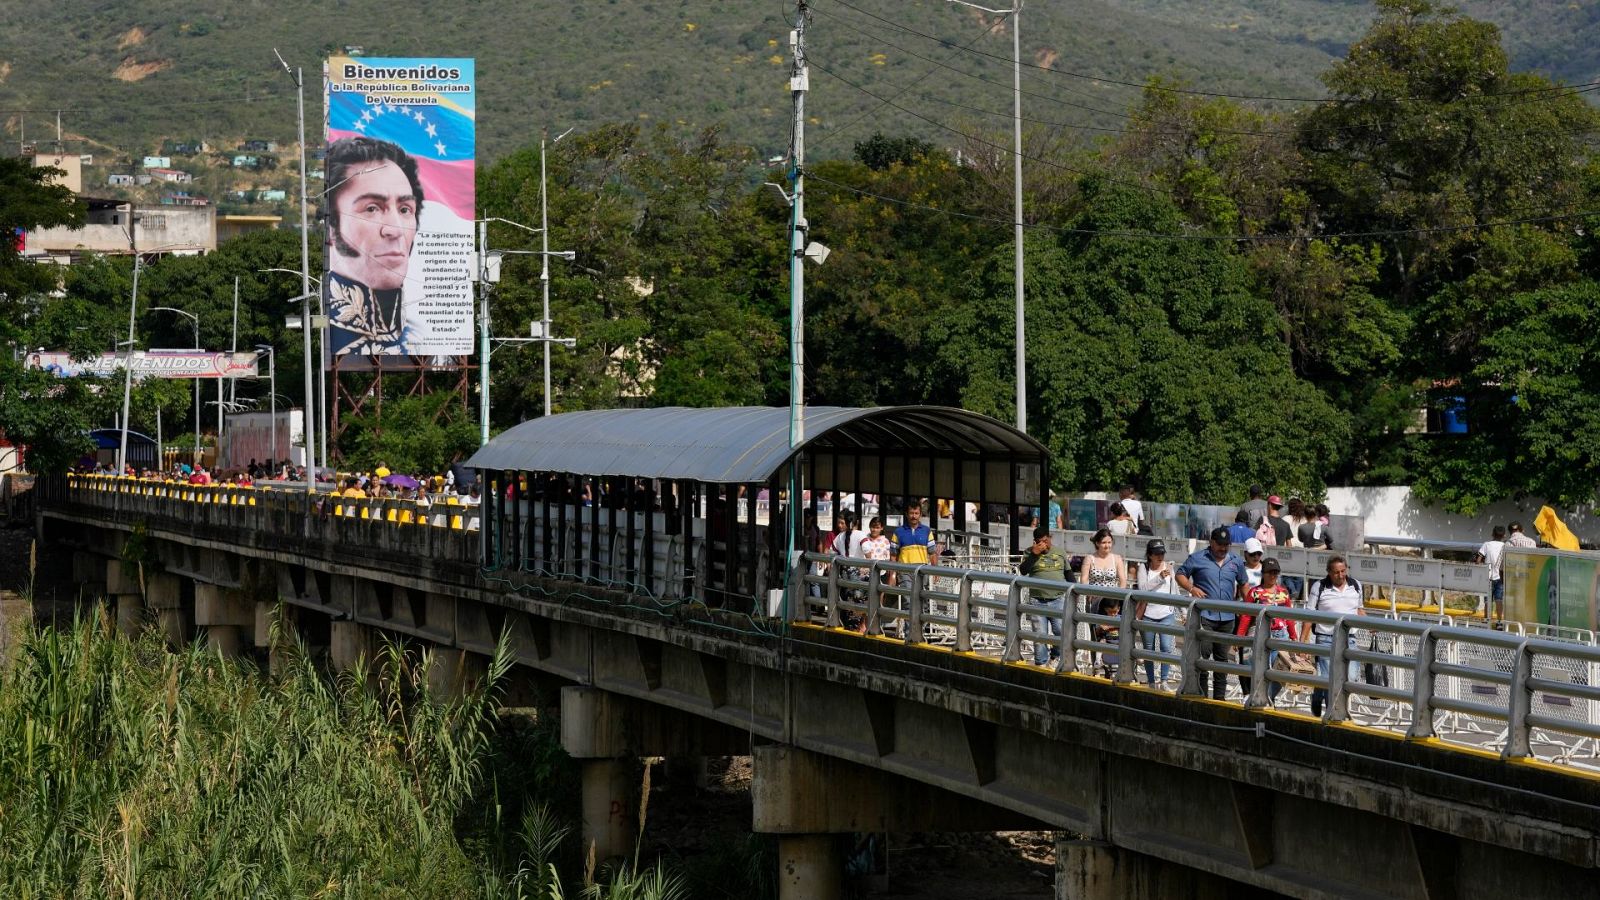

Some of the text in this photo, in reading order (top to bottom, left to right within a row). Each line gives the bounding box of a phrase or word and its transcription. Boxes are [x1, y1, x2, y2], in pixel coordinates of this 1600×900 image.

[344, 65, 460, 79] Bienvenidos
[343, 83, 352, 91] la
[356, 83, 408, 92] República
[411, 83, 470, 91] Bolivariana
[366, 95, 437, 104] De Venezuela
